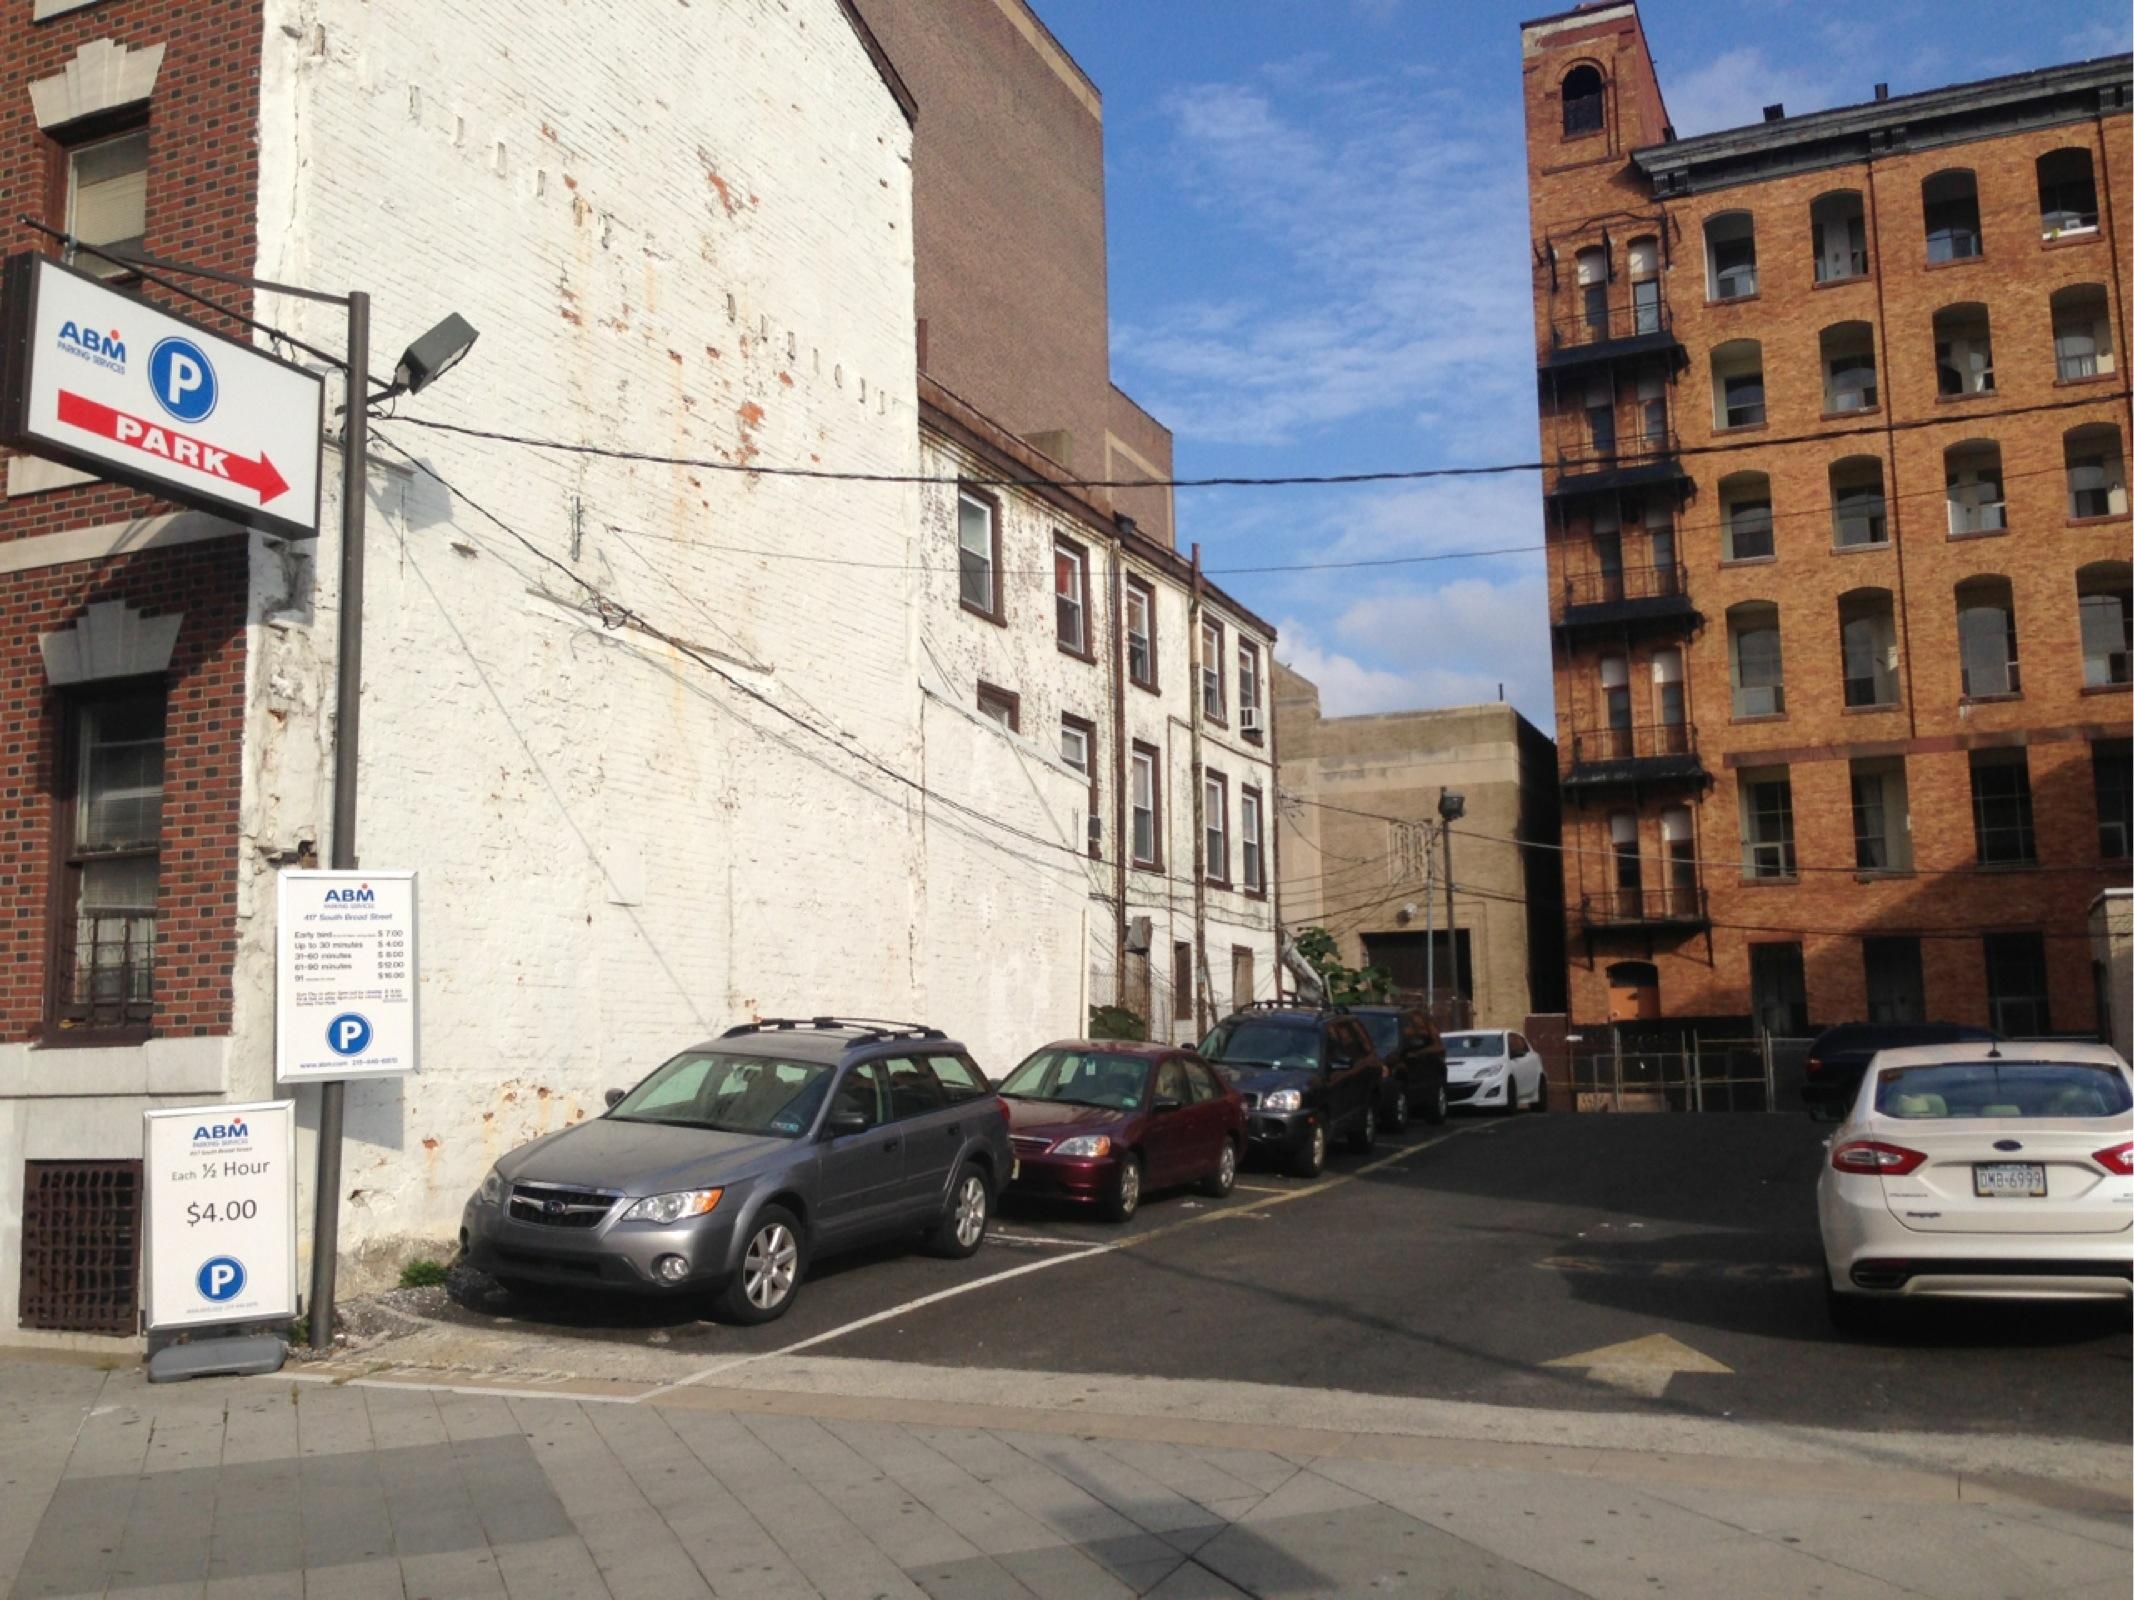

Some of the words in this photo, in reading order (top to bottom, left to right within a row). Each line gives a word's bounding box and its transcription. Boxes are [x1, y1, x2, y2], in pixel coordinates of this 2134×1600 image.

[58, 321, 126, 364] ABM
[168, 352, 202, 405] P
[116, 414, 229, 478] PARK
[324, 887, 375, 902] ABM
[294, 931, 314, 939] Early
[294, 942, 306, 950] Up
[319, 941, 331, 949] 30
[332, 941, 363, 949] minutes
[340, 1021, 363, 1049] P
[193, 1122, 249, 1141] ABM
[171, 1170, 197, 1181] Each
[224, 1161, 271, 1177] Hour
[186, 1199, 258, 1227] $4.00
[211, 1264, 236, 1296] P
